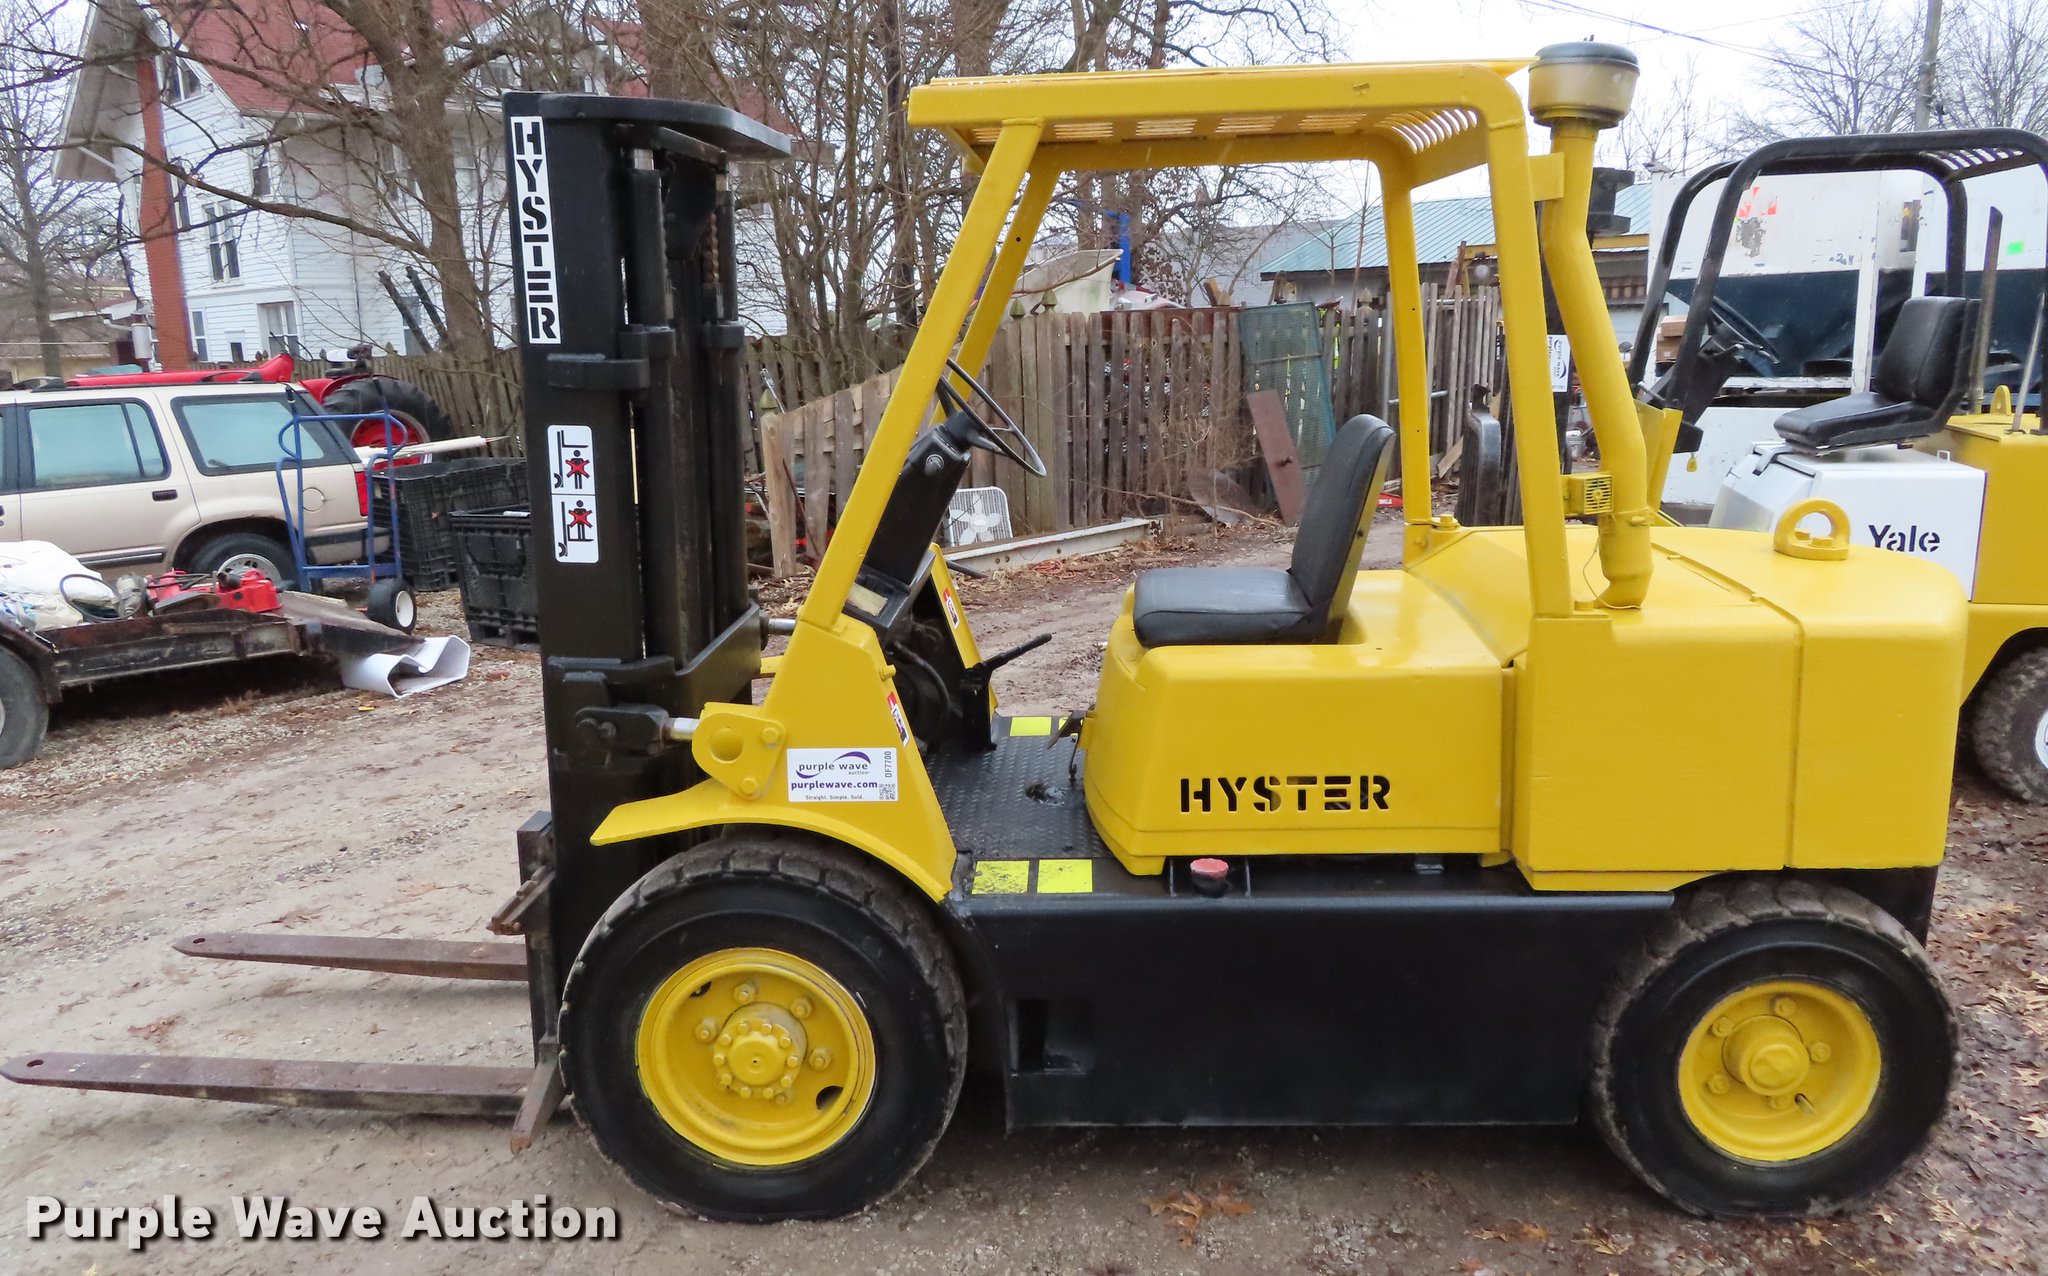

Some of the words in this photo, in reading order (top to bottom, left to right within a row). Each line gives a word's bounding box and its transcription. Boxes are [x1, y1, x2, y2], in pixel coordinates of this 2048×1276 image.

[513, 121, 557, 340] HYSTER
[1868, 524, 1940, 552] Yale
[799, 762, 835, 771] purple
[884, 751, 892, 778] DF7700
[791, 780, 878, 790] purplewave.com
[1180, 775, 1391, 813] HYSTER
